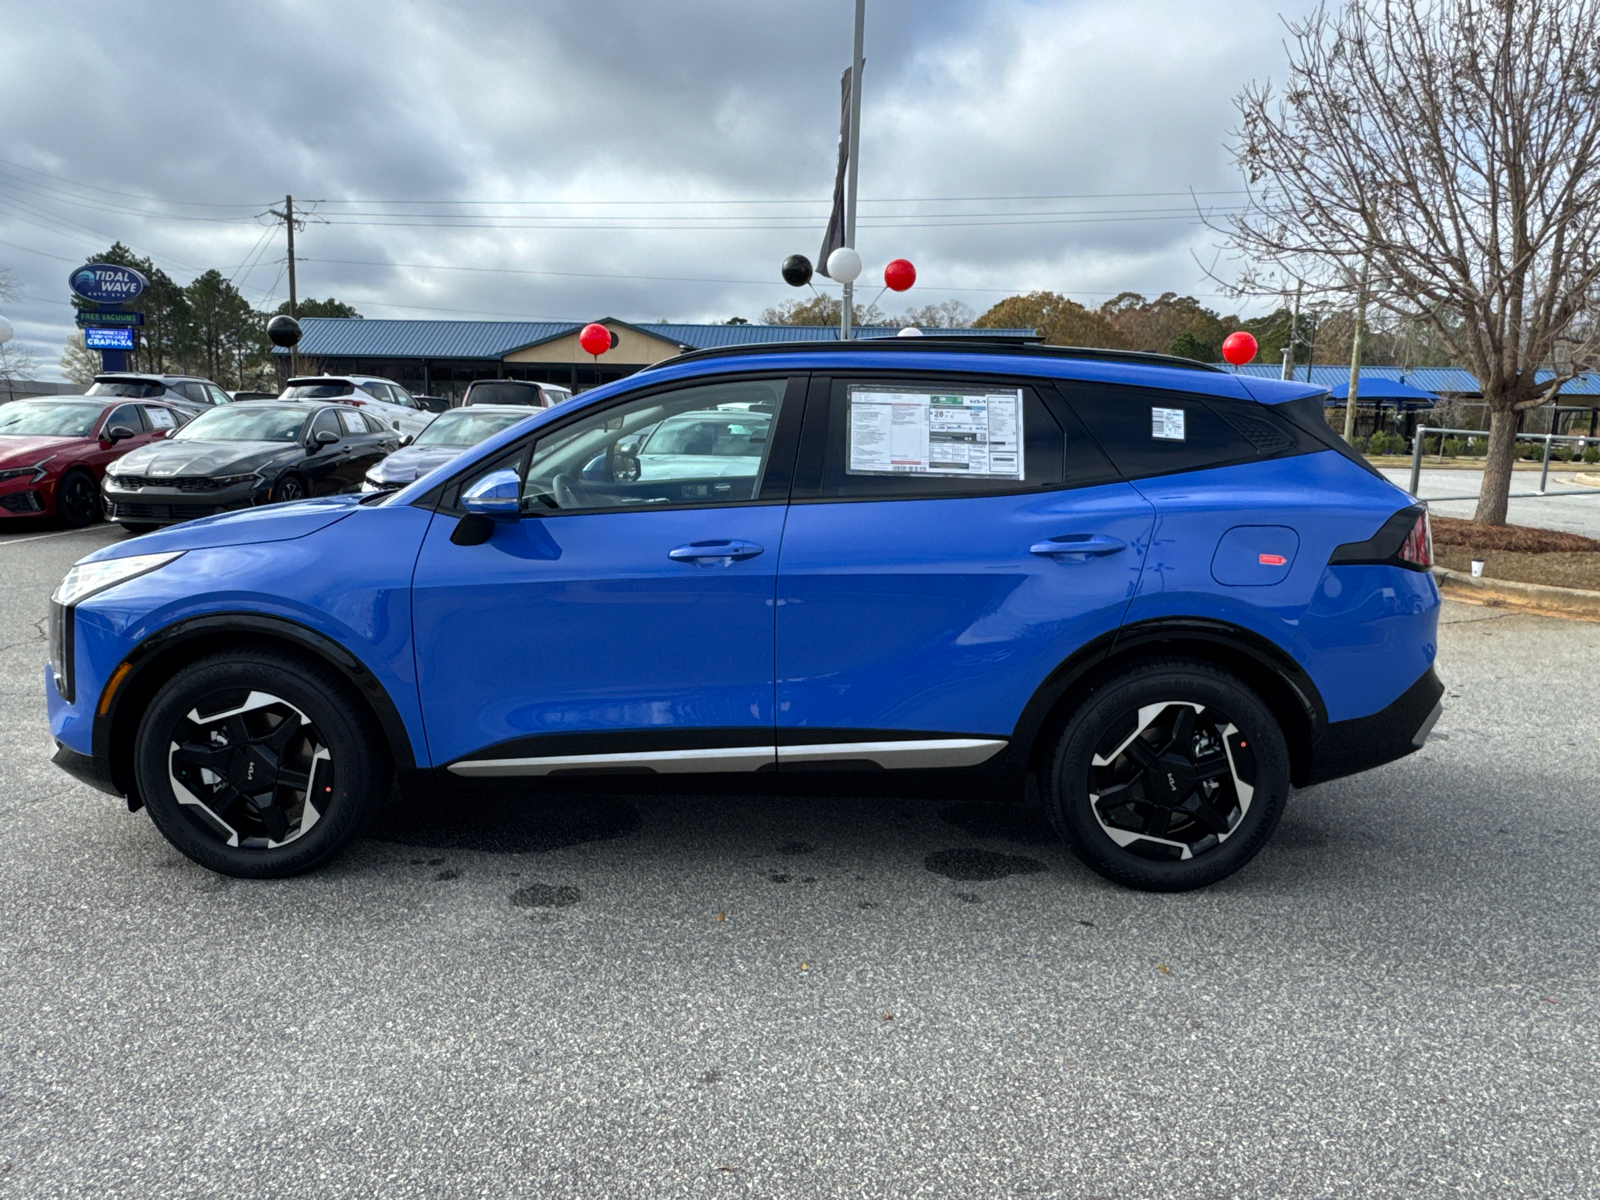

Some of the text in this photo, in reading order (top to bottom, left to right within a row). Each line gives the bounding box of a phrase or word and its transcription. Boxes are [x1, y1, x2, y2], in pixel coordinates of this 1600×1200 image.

[95, 271, 129, 282] TIDAL
[101, 281, 137, 292] WAVE
[101, 313, 136, 322] VACUUMS
[934, 410, 944, 418] 28
[1243, 794, 1279, 852] KUMHO
